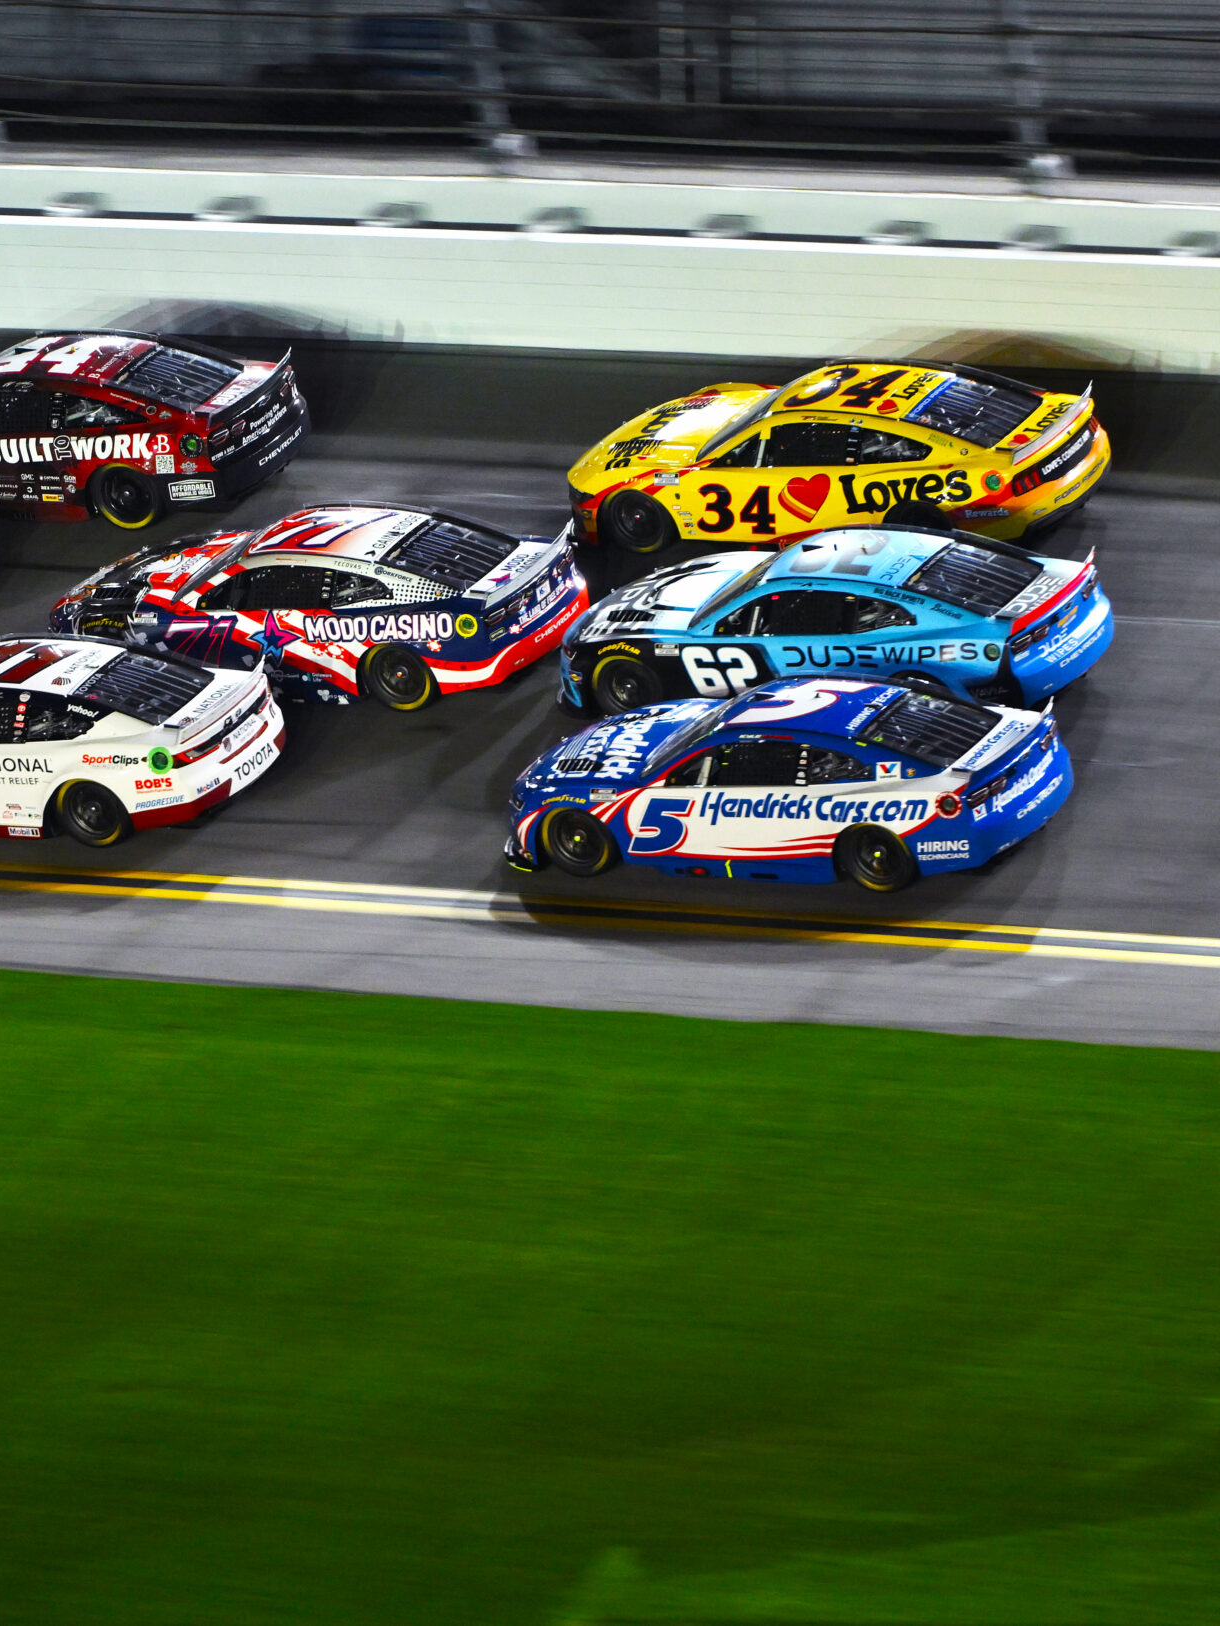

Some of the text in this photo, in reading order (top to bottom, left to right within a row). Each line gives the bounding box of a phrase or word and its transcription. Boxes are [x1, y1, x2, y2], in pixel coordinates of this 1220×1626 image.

[783, 367, 910, 408] 34
[250, 408, 273, 430] Powering
[53, 435, 72, 460] TO
[70, 432, 153, 460] WORK
[156, 434, 171, 454] B
[242, 425, 268, 446] American
[258, 426, 303, 467] CHEVROLET
[171, 482, 212, 493] AFFORDABLE
[697, 483, 776, 535] 34
[964, 506, 1010, 519] Rewards
[333, 560, 362, 570] TECOVAS
[880, 556, 912, 581] DUDE
[1005, 576, 1052, 613] DUDE
[81, 617, 125, 630] GOODYEAR
[304, 612, 454, 642] MODO CASINO
[534, 600, 580, 643] CHEVROLET
[597, 641, 641, 655] GOODYEAR
[783, 642, 978, 669] DUDE WIPES
[1044, 638, 1079, 663] WIPES
[1060, 625, 1106, 668] CHEVROLET
[682, 646, 758, 698] 62
[75, 673, 105, 695] TOYOTA
[66, 703, 100, 718] yahoo!
[845, 687, 899, 731] HIRING TECHS
[82, 754, 139, 767] SportClips
[234, 742, 274, 781] TOYOTA
[9, 777, 39, 785] RELIEF
[135, 778, 173, 790] BOB'S
[196, 781, 214, 795] Mobil
[135, 795, 185, 811] PROGRESSIVE
[541, 794, 587, 805] GOODYEAR
[699, 791, 929, 826] Hendrick Cars.com
[9, 828, 31, 836] Mobil
[628, 797, 696, 856] 5
[917, 840, 970, 853] HIRING
[918, 852, 970, 861] TECHNICIANS
